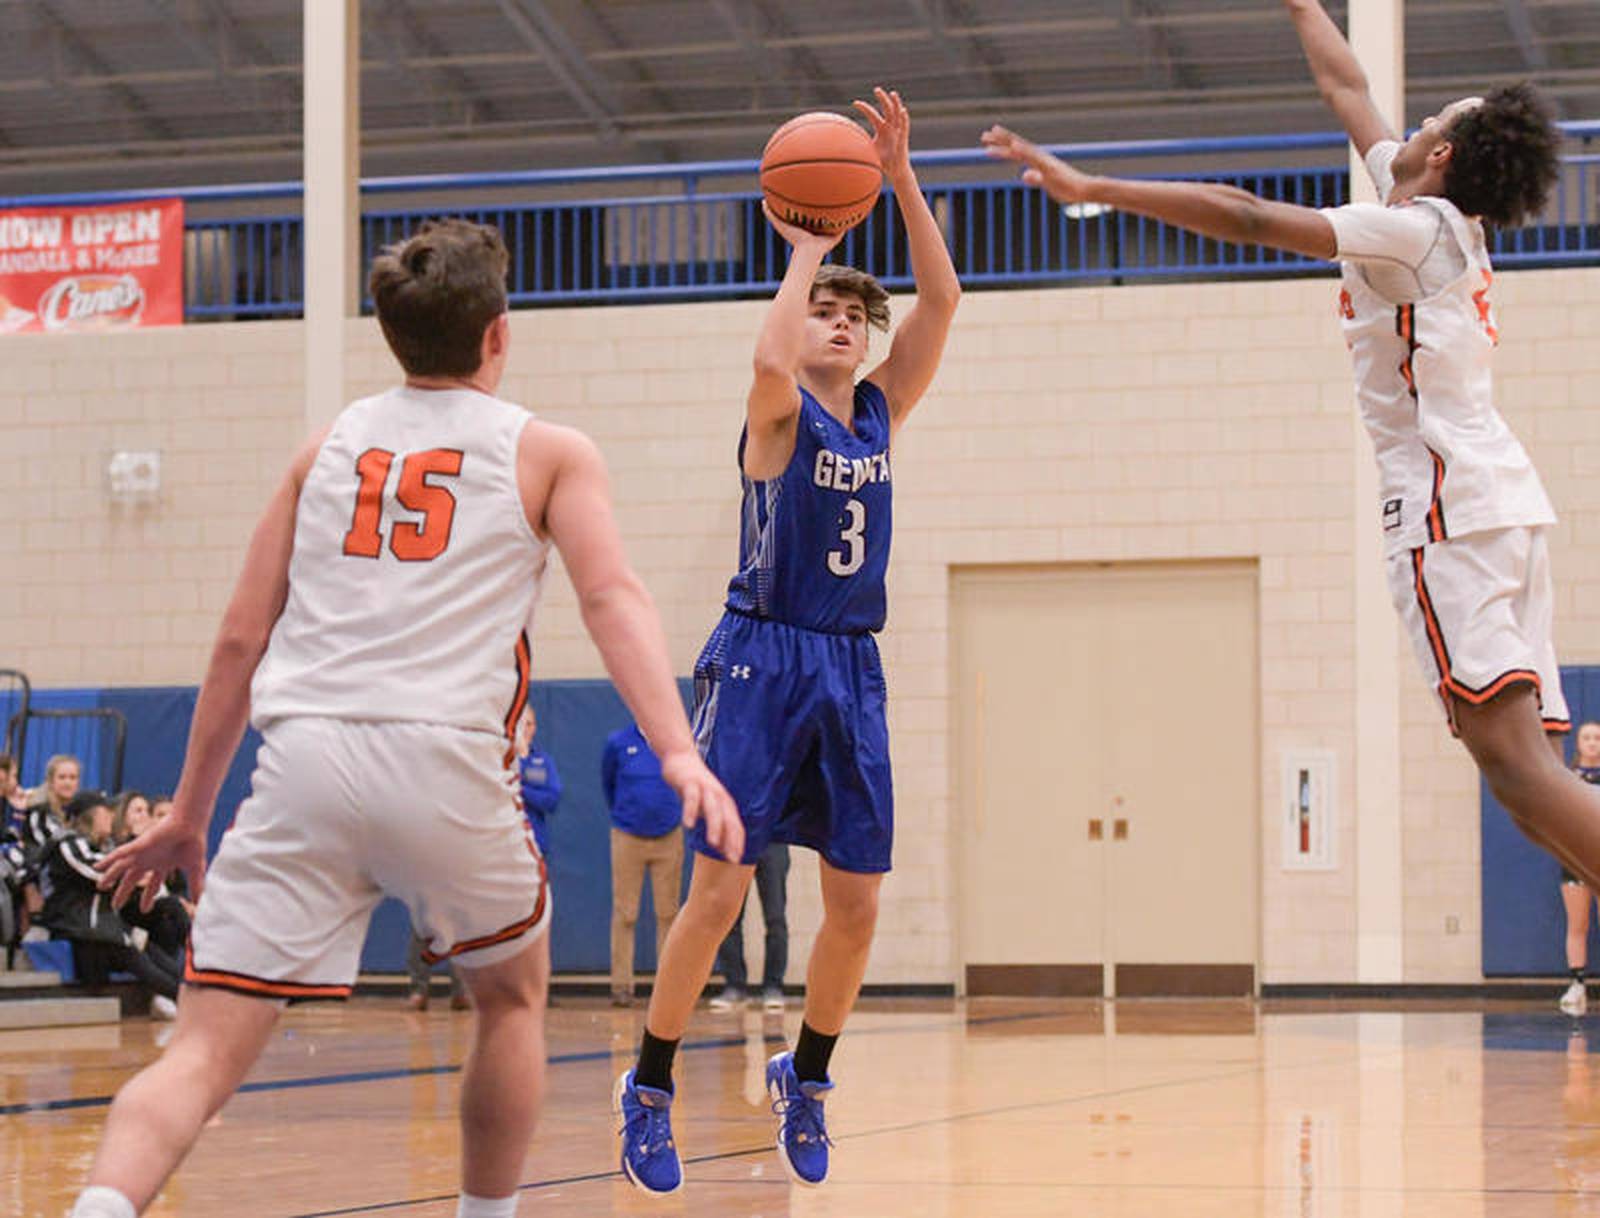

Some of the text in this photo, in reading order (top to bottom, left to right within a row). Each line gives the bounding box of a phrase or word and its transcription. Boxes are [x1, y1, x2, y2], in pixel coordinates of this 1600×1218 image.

[71, 208, 161, 246] OPEN
[343, 447, 464, 562] 15
[827, 499, 866, 577] 3
